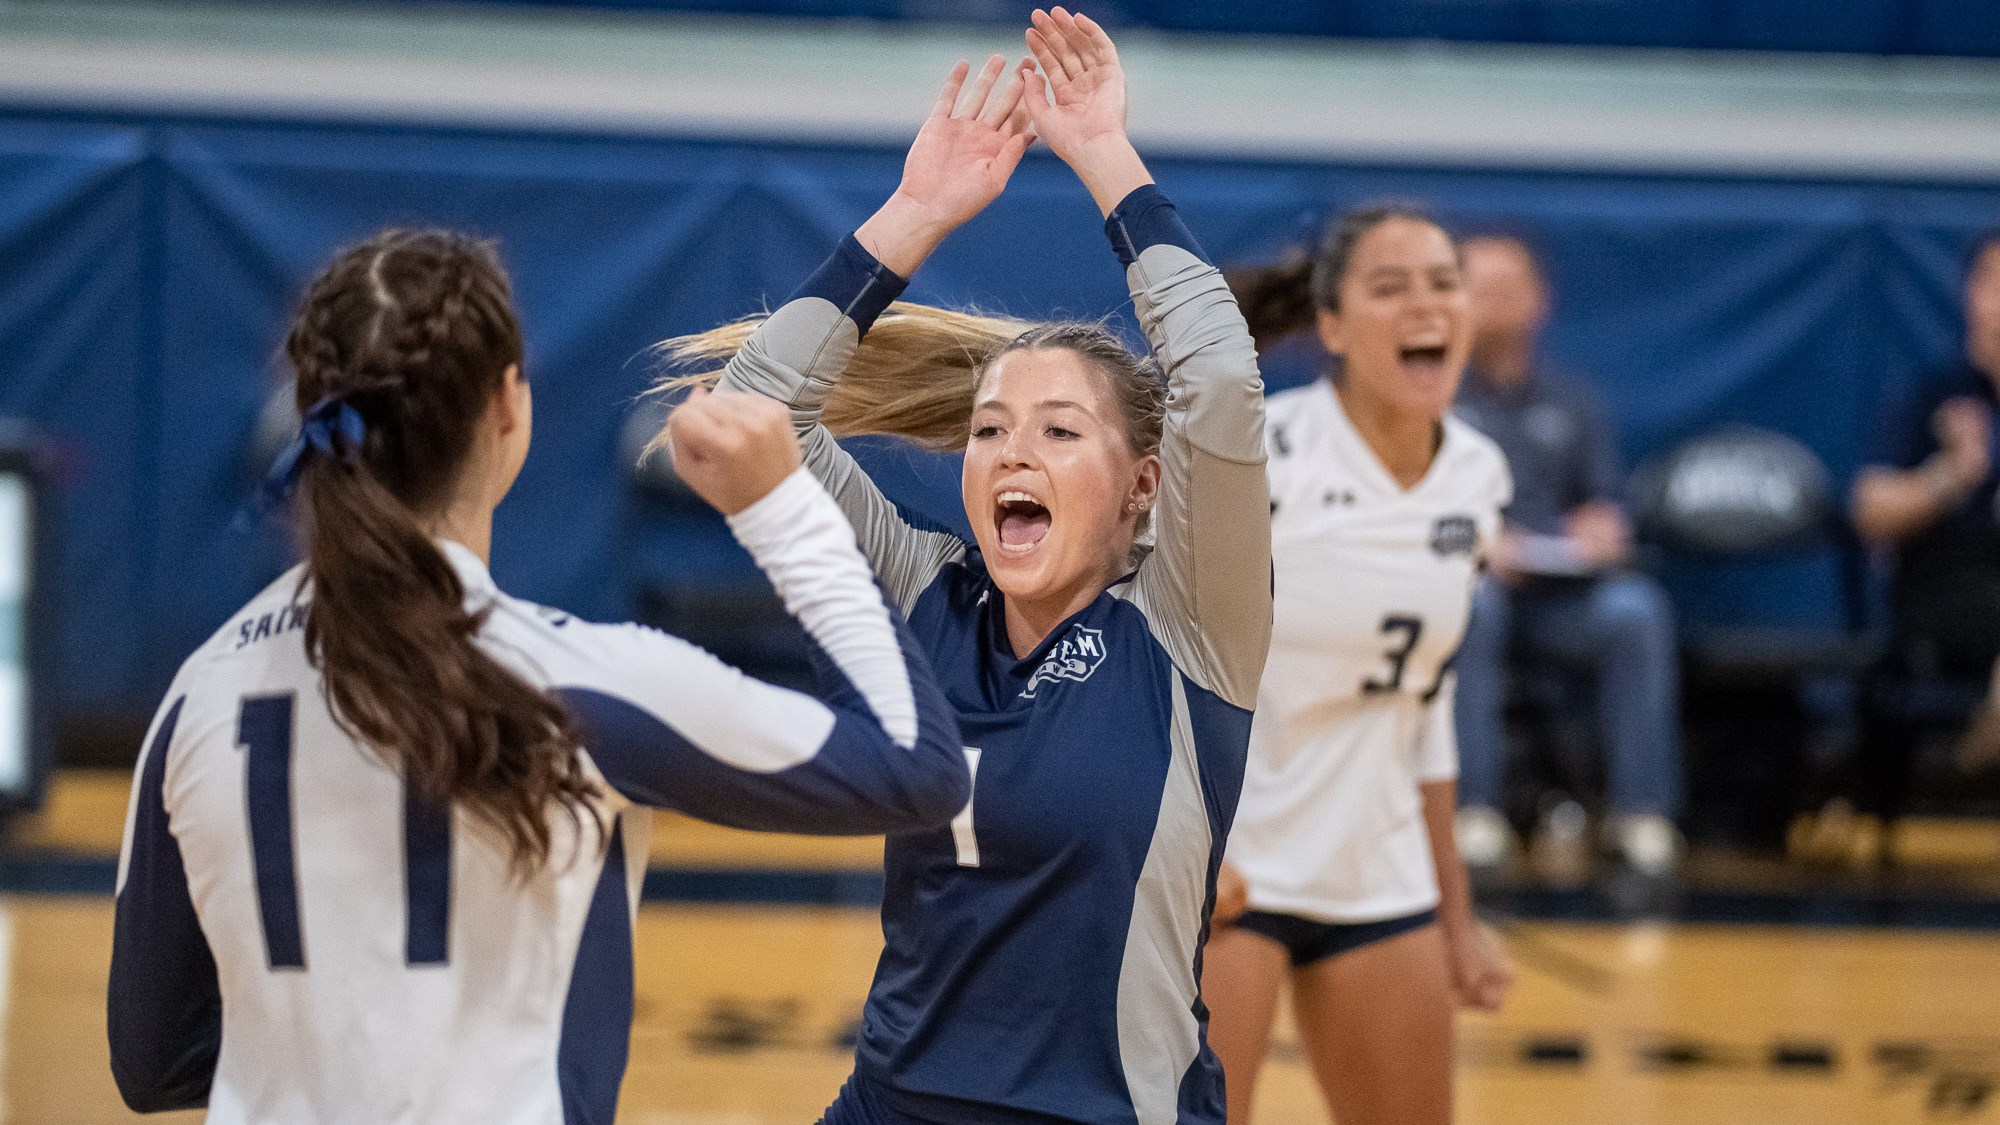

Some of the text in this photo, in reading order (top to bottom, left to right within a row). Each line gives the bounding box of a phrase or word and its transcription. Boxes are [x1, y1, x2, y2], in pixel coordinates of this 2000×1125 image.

[1035, 660, 1076, 681] HAWS
[1361, 614, 1423, 697] 3
[235, 690, 455, 972] 11
